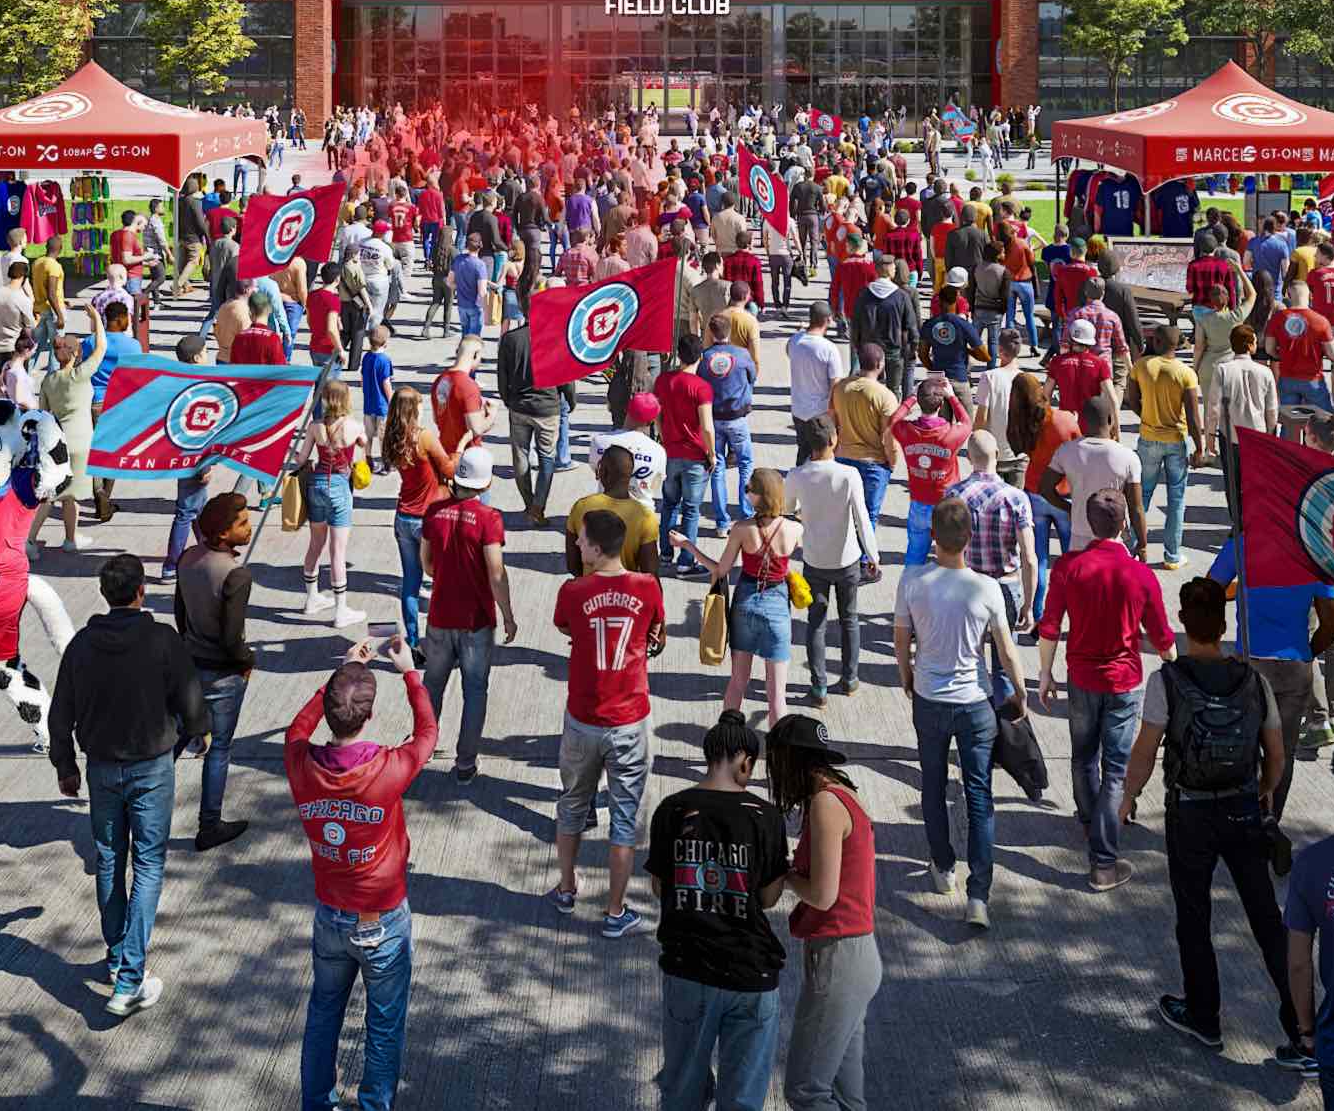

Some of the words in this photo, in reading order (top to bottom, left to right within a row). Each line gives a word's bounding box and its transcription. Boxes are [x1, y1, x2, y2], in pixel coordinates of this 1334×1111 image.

[111, 145, 150, 157] GT-ON
[187, 401, 220, 431] C
[119, 458, 156, 469] FAN
[589, 617, 635, 672] 17
[298, 798, 385, 825] CHICAGO
[673, 839, 750, 868] CHICAGO
[675, 889, 749, 920] FIRE
